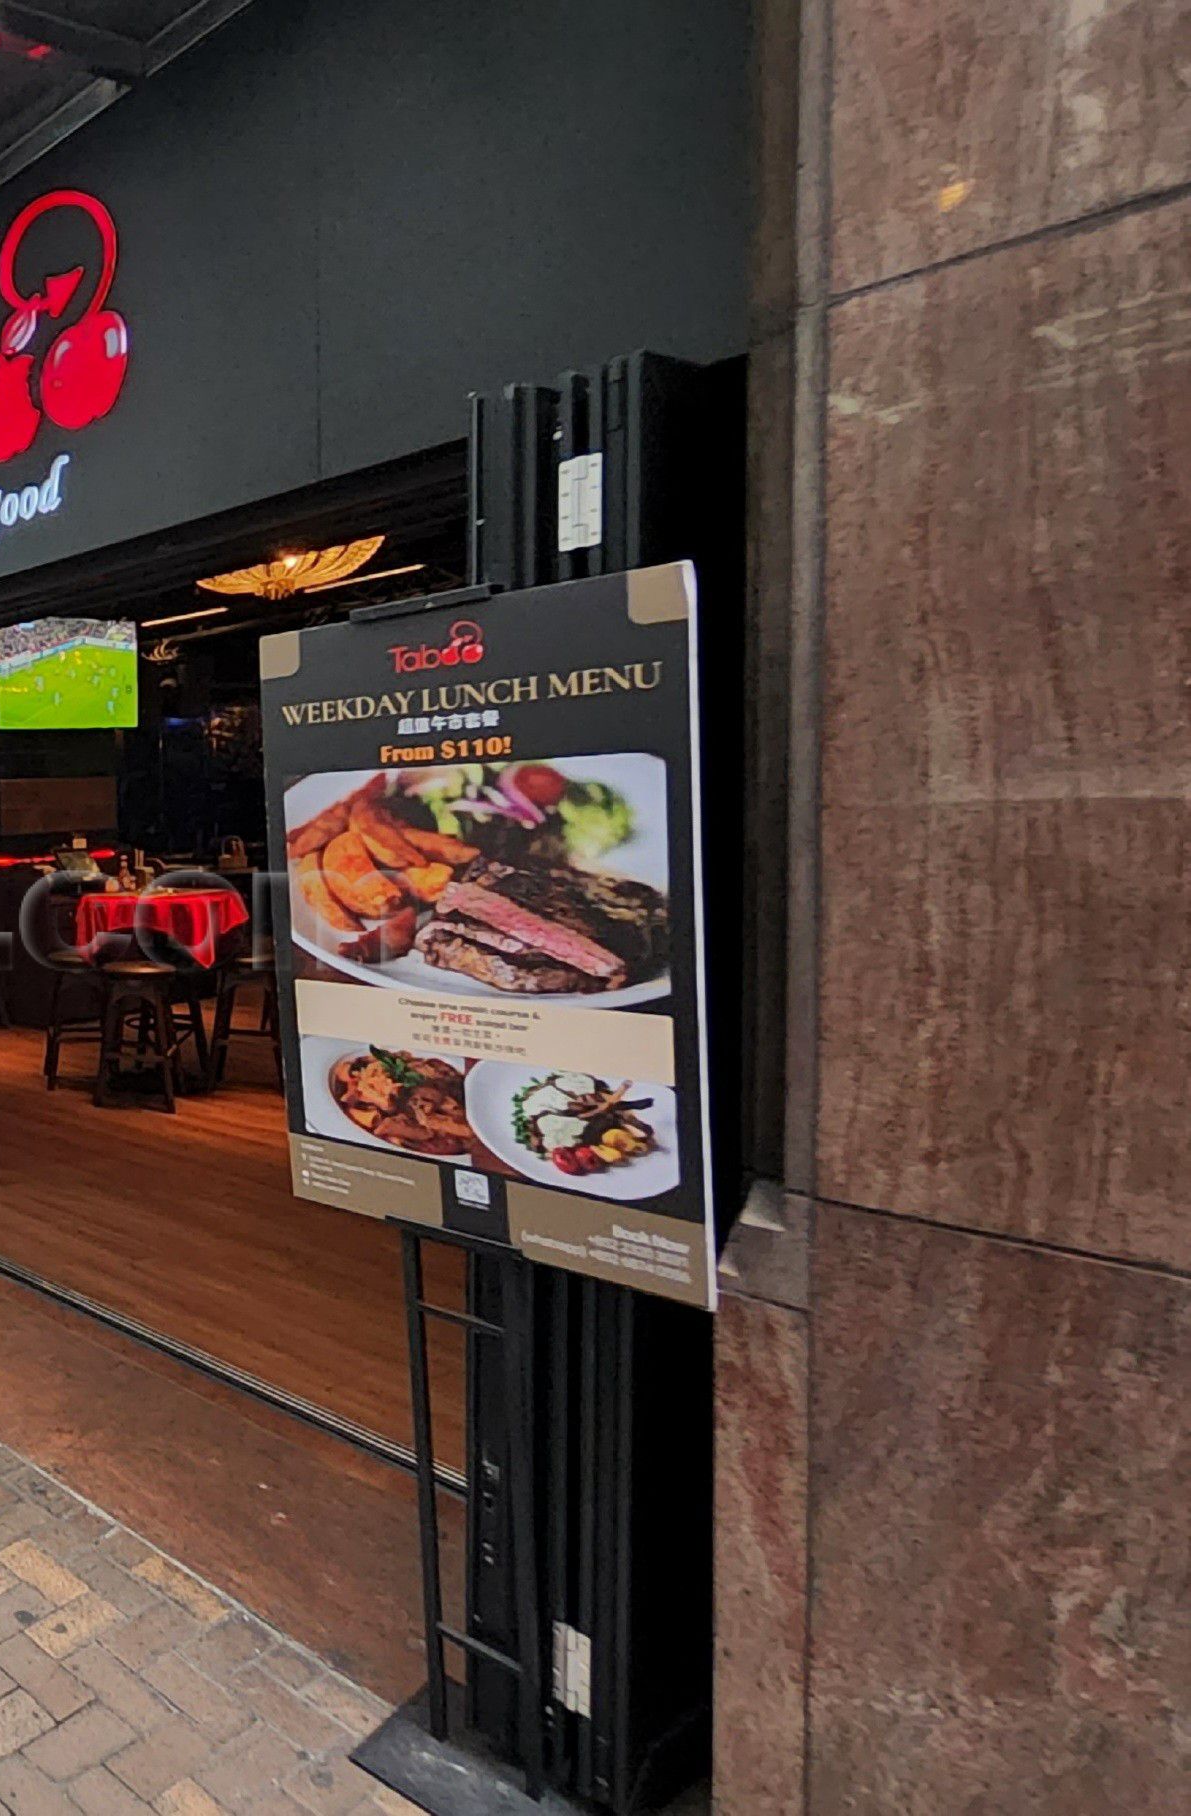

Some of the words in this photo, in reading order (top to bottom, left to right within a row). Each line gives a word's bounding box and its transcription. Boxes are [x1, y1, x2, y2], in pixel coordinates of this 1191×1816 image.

[388, 630, 484, 674] Taboo
[282, 689, 416, 726] WEEKDAY
[422, 674, 538, 712] LUNCH
[547, 661, 663, 698] MENU
[380, 745, 434, 763] From
[440, 1011, 473, 1025] FREE
